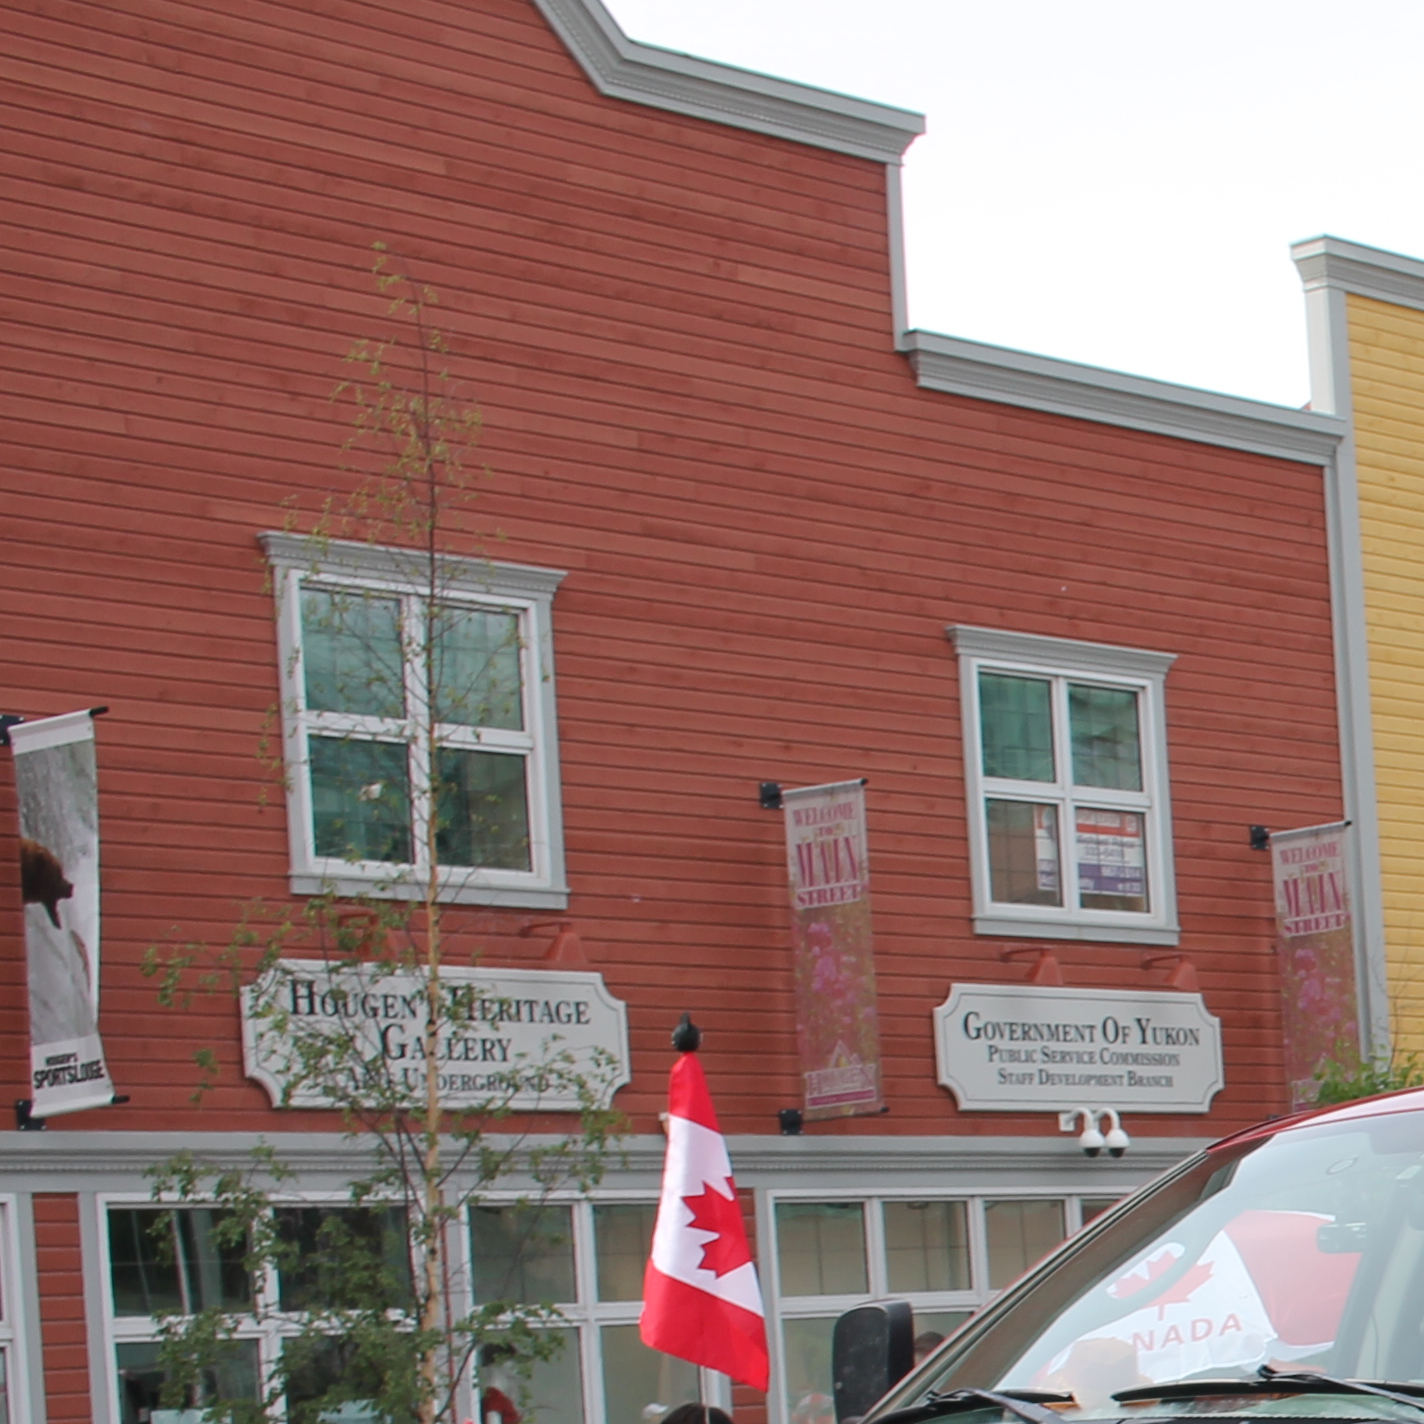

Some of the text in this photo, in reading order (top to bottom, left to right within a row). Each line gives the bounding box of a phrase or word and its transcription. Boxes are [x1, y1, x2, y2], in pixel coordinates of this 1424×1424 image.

[793, 803, 855, 826] WELCOME
[796, 836, 859, 887] MAIN
[1281, 842, 1338, 864] WELCOME
[797, 883, 860, 906] STREET
[1283, 873, 1342, 917] MAIN
[1284, 913, 1342, 934] STREET
[289, 979, 440, 1018] HOUGEN'
[1135, 1018, 1200, 1046] YUKON
[1131, 1313, 1243, 1351] NADA
